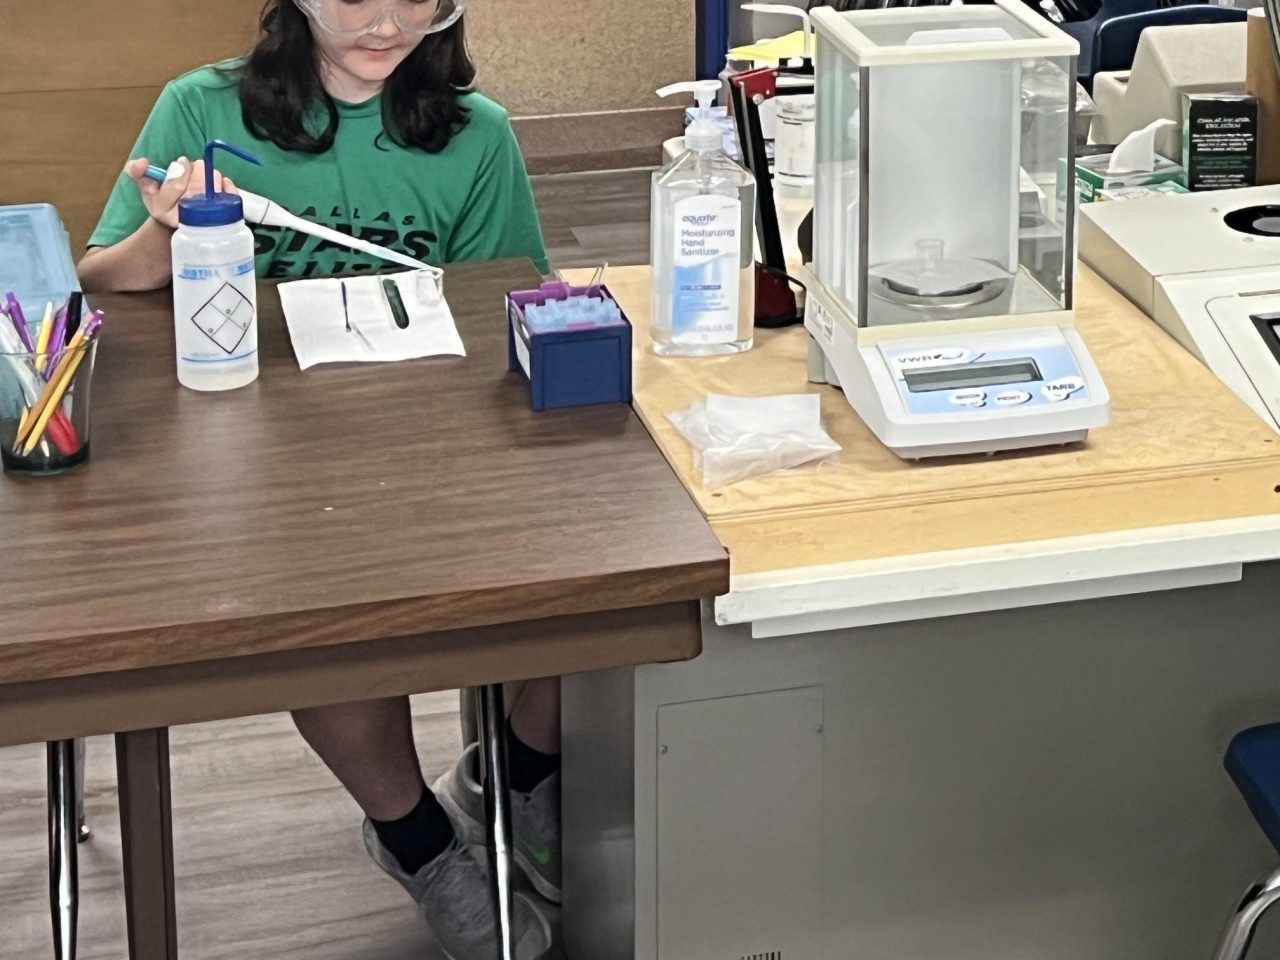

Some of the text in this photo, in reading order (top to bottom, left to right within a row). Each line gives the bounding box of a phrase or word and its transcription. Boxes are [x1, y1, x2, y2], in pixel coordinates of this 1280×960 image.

[281, 205, 416, 226] ALLAS
[681, 229, 735, 238] Moisturizing
[681, 239, 705, 247] Hand
[681, 248, 719, 256] Sanitizer
